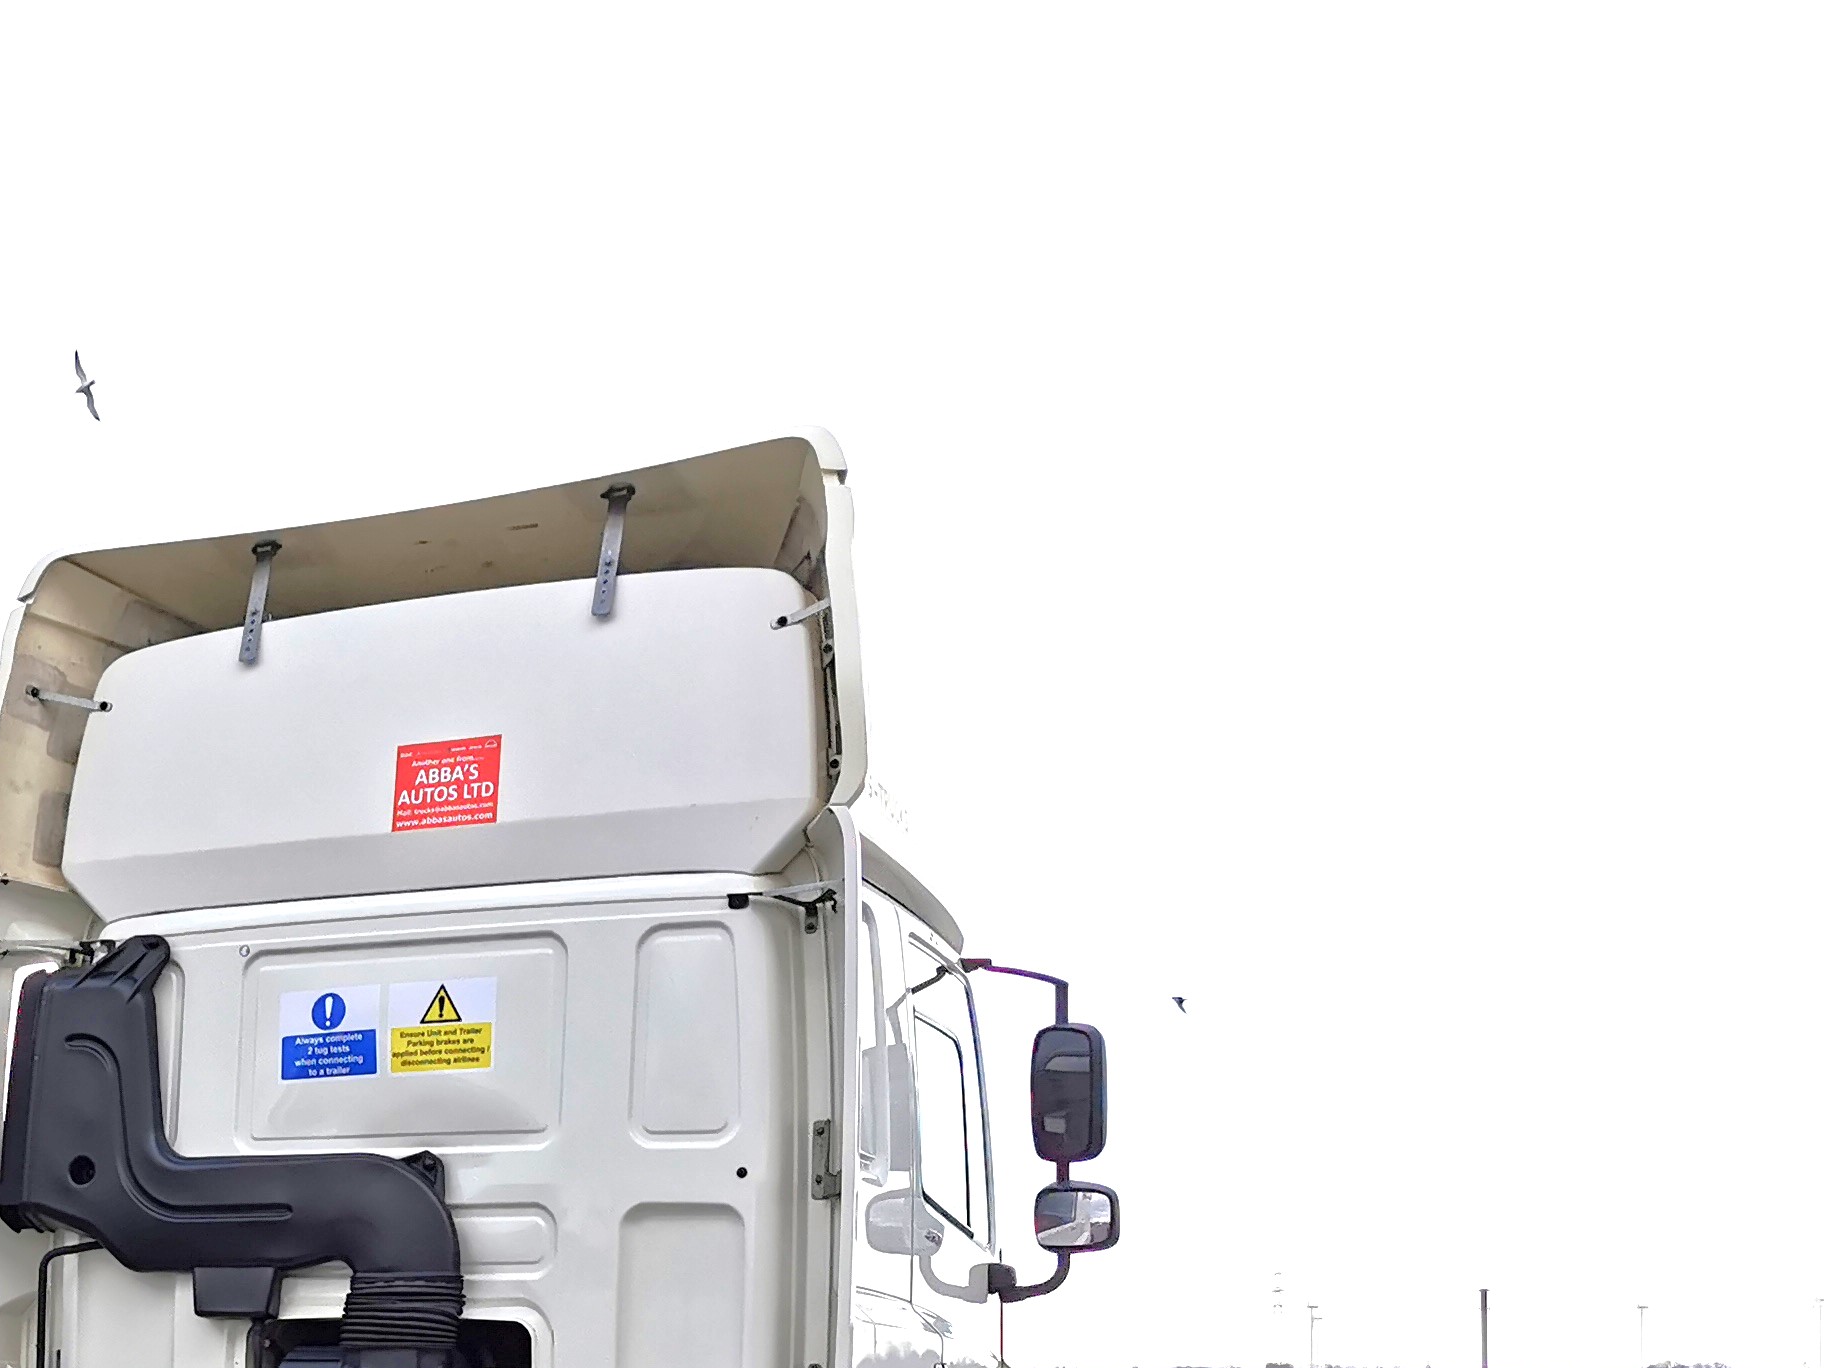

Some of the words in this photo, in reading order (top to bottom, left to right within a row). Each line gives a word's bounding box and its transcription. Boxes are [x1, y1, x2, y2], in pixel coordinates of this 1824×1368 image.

[415, 764, 479, 786] ABBA'S
[397, 785, 458, 806] AUTOS
[463, 781, 494, 799] LTD
[400, 1031, 425, 1039] Ensure
[427, 1029, 442, 1037] Unit
[443, 1028, 457, 1036] and
[459, 1027, 482, 1035] Trailer
[295, 1036, 324, 1046] Always
[326, 1033, 363, 1043] complete
[406, 1039, 434, 1048] Parking
[436, 1038, 460, 1046] brakes
[307, 1046, 313, 1055] 2
[315, 1046, 329, 1055] tug
[330, 1045, 350, 1053] tests
[392, 1049, 418, 1059] applied
[419, 1048, 442, 1056] before
[444, 1046, 485, 1055] connecting
[294, 1058, 317, 1067] when
[318, 1055, 364, 1065] connecting
[401, 1057, 451, 1067] disconnecting
[453, 1056, 480, 1064] airlines
[308, 1068, 317, 1076] to
[326, 1066, 350, 1075] trailer
